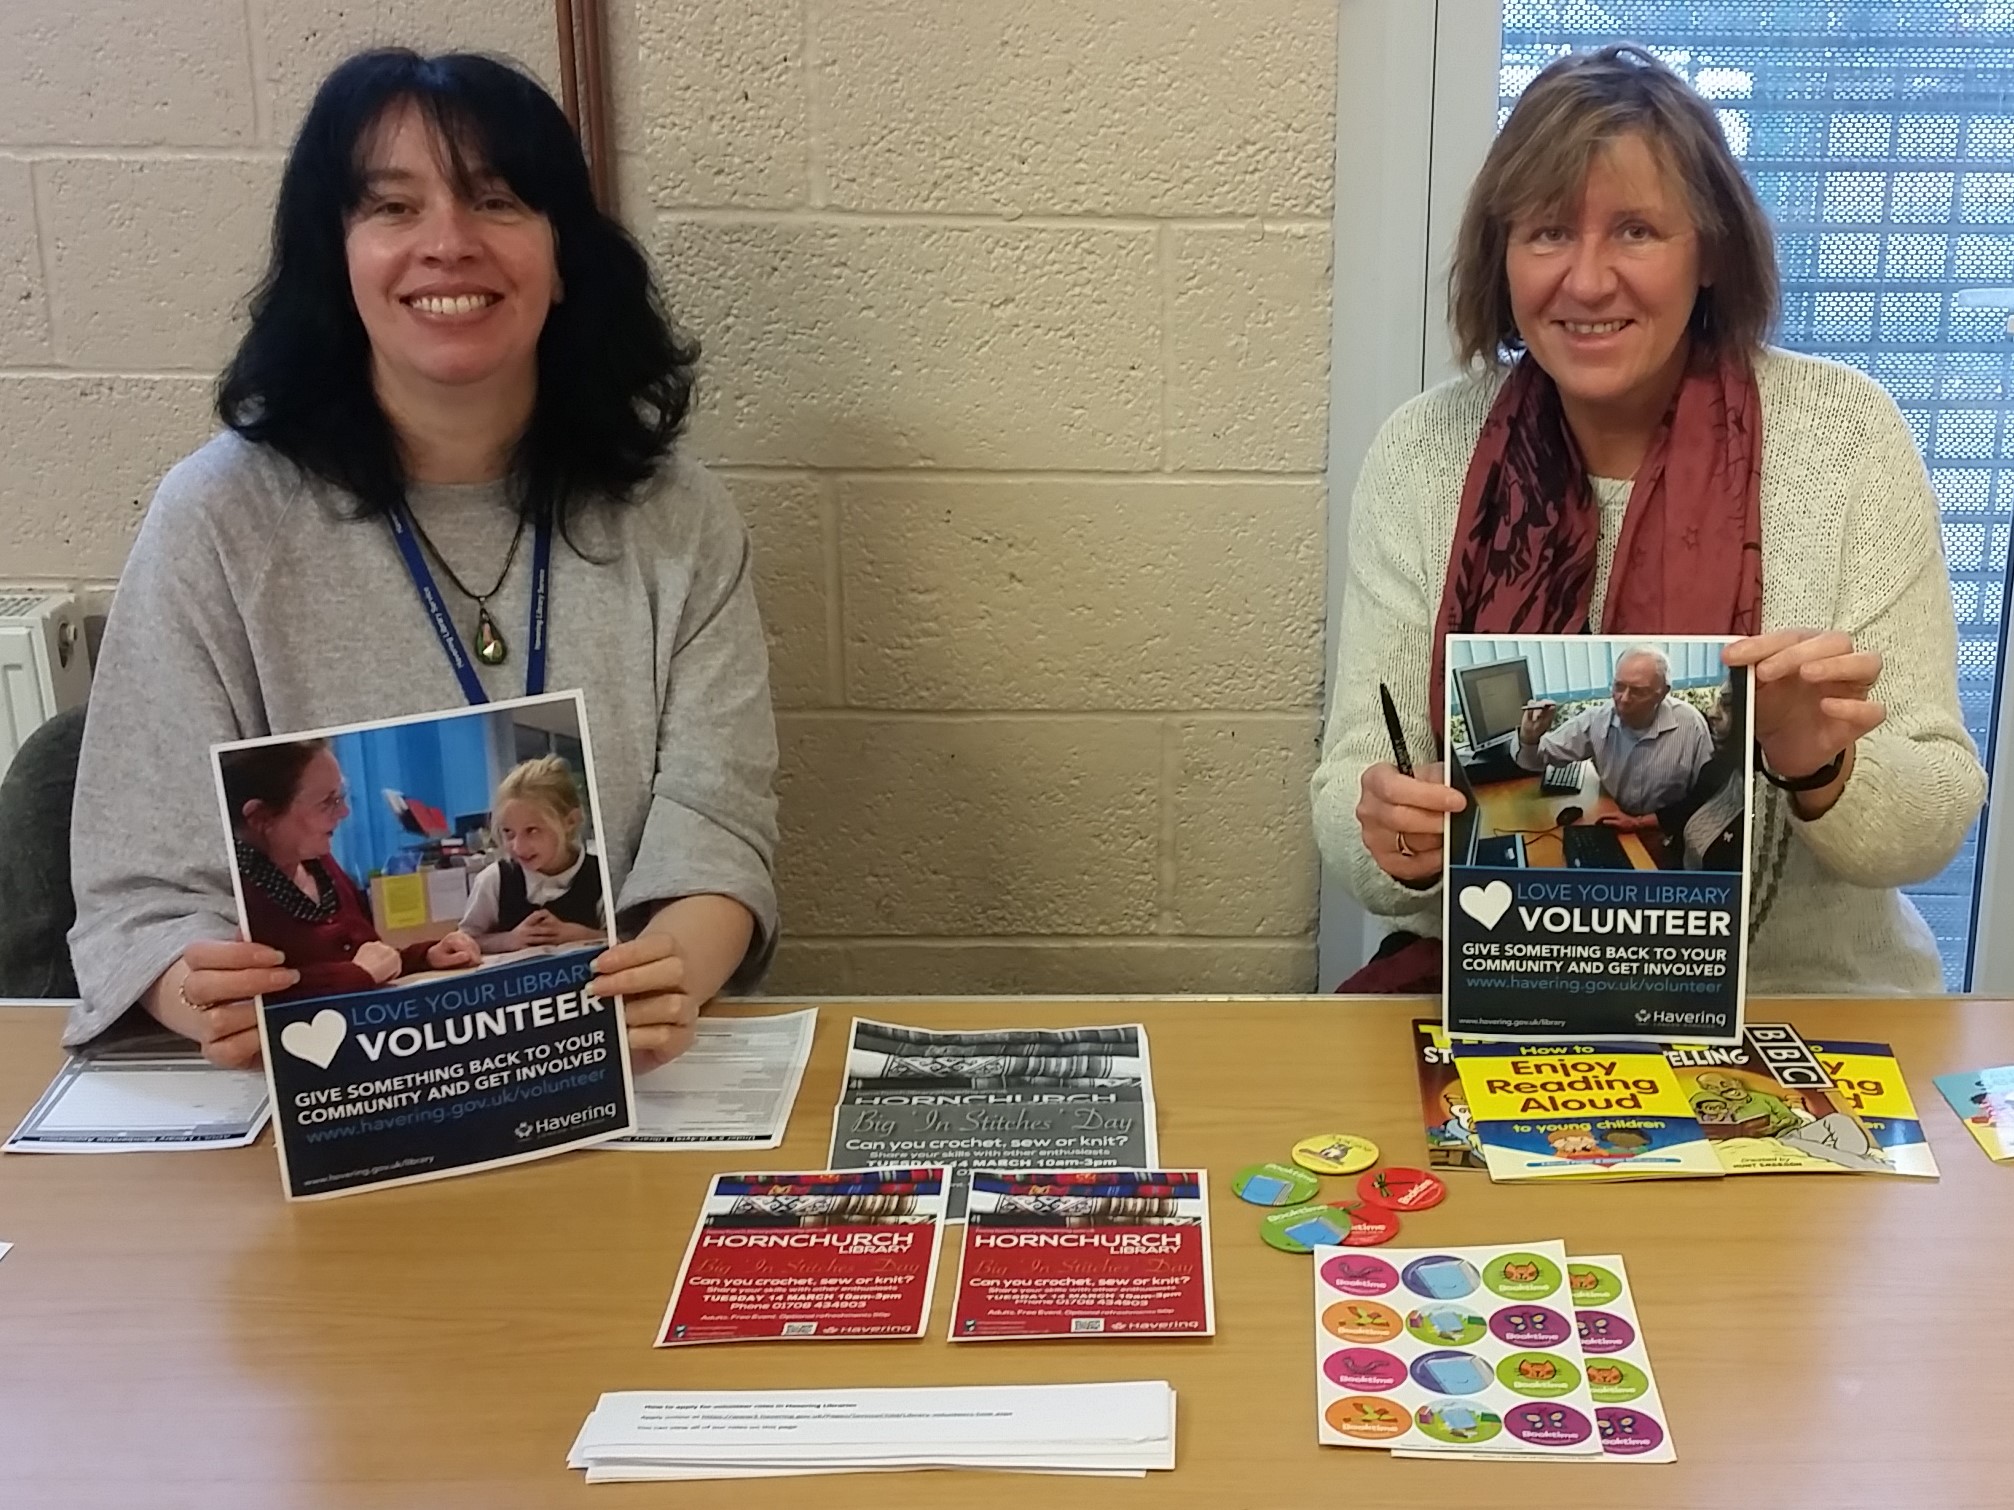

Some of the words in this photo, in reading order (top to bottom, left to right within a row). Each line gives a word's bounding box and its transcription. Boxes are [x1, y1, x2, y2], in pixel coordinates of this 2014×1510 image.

[1517, 883, 1571, 901] LOVE
[1577, 884, 1637, 902] YOUR
[1645, 886, 1731, 904] LIBRARY
[1517, 906, 1731, 936] VOLUNTEER
[1462, 942, 1501, 956] GIVE
[1504, 944, 1601, 959] SOMETHING
[1605, 946, 1650, 960] BACK
[1653, 948, 1677, 961] TO
[1680, 948, 1727, 961] YOUR
[1462, 958, 1564, 973] COMMUNITY
[1567, 961, 1604, 974] AND
[1607, 962, 1641, 975] GET
[1643, 963, 1726, 976] INVOLVED
[1466, 975, 1722, 994] www.havering.gov.uk/volunteer
[351, 1000, 419, 1026] LOVE
[424, 983, 497, 1013] YOUR
[355, 989, 606, 1062] VOLUNTEER
[1458, 1017, 1567, 1027] www.havering.gov.uk/library
[1653, 1010, 1727, 1028] Havering
[1519, 1046, 1568, 1056] How
[1572, 1045, 1595, 1054] to
[1663, 1048, 1749, 1067] ELLING
[1753, 1029, 1818, 1083] BBC
[294, 1087, 343, 1109] GIVE
[346, 1063, 465, 1099] SOMETHING
[469, 1051, 521, 1075] BACK
[523, 1044, 551, 1062] TO
[554, 1030, 605, 1055] YOUR
[1510, 1058, 1617, 1077] Enjoy
[297, 1090, 422, 1125] COMMUNITY
[427, 1080, 470, 1102] AND
[474, 1071, 512, 1091] GET
[515, 1048, 607, 1082] INVOLVED
[1486, 1075, 1660, 1095] Reading
[306, 1068, 607, 1145] www.havering.gov.uk/volunteer
[855, 1093, 1117, 1106] HORNCHURCH
[1519, 1092, 1643, 1113] Aloud
[536, 1102, 617, 1133] Havering
[852, 1109, 896, 1138] Big
[1072, 1107, 1133, 1136] Day
[1512, 1124, 1532, 1134] to
[1535, 1122, 1592, 1134] young
[1595, 1118, 1666, 1131] children
[846, 1140, 886, 1150] Can
[889, 1141, 926, 1152] you
[929, 1137, 1007, 1149] crochet,
[1010, 1139, 1052, 1148] sew
[1055, 1138, 1077, 1147] or
[1079, 1136, 1129, 1147] knit?
[972, 1150, 1001, 1158] with
[972, 1159, 1032, 1167] MARCH
[1036, 1158, 1118, 1167] 10am-3pm
[702, 1232, 915, 1248] HORNCHURCH
[975, 1232, 1182, 1248] HORNCHURCH
[838, 1245, 912, 1255] LIBRARY
[1110, 1245, 1181, 1255] LIBRARY
[689, 1276, 722, 1286] Can
[724, 1278, 754, 1288] you
[755, 1277, 817, 1287] crochet,
[819, 1278, 854, 1286] sew
[875, 1275, 916, 1285] knit?
[969, 1278, 1001, 1287] Can
[1003, 1279, 1033, 1289] you
[1034, 1277, 1096, 1287] crochet,
[1098, 1278, 1130, 1287] sew
[1132, 1278, 1151, 1286] or
[1151, 1276, 1191, 1286] knit?
[1335, 1278, 1388, 1289] Booktime
[702, 1294, 765, 1303] TUESDAY
[768, 1294, 784, 1302] 14
[786, 1293, 835, 1301] MARCH
[730, 1302, 771, 1311] Phone
[840, 1325, 912, 1335] Havering
[1128, 1321, 1200, 1330] Havering
[1339, 1375, 1394, 1385] Booktime
